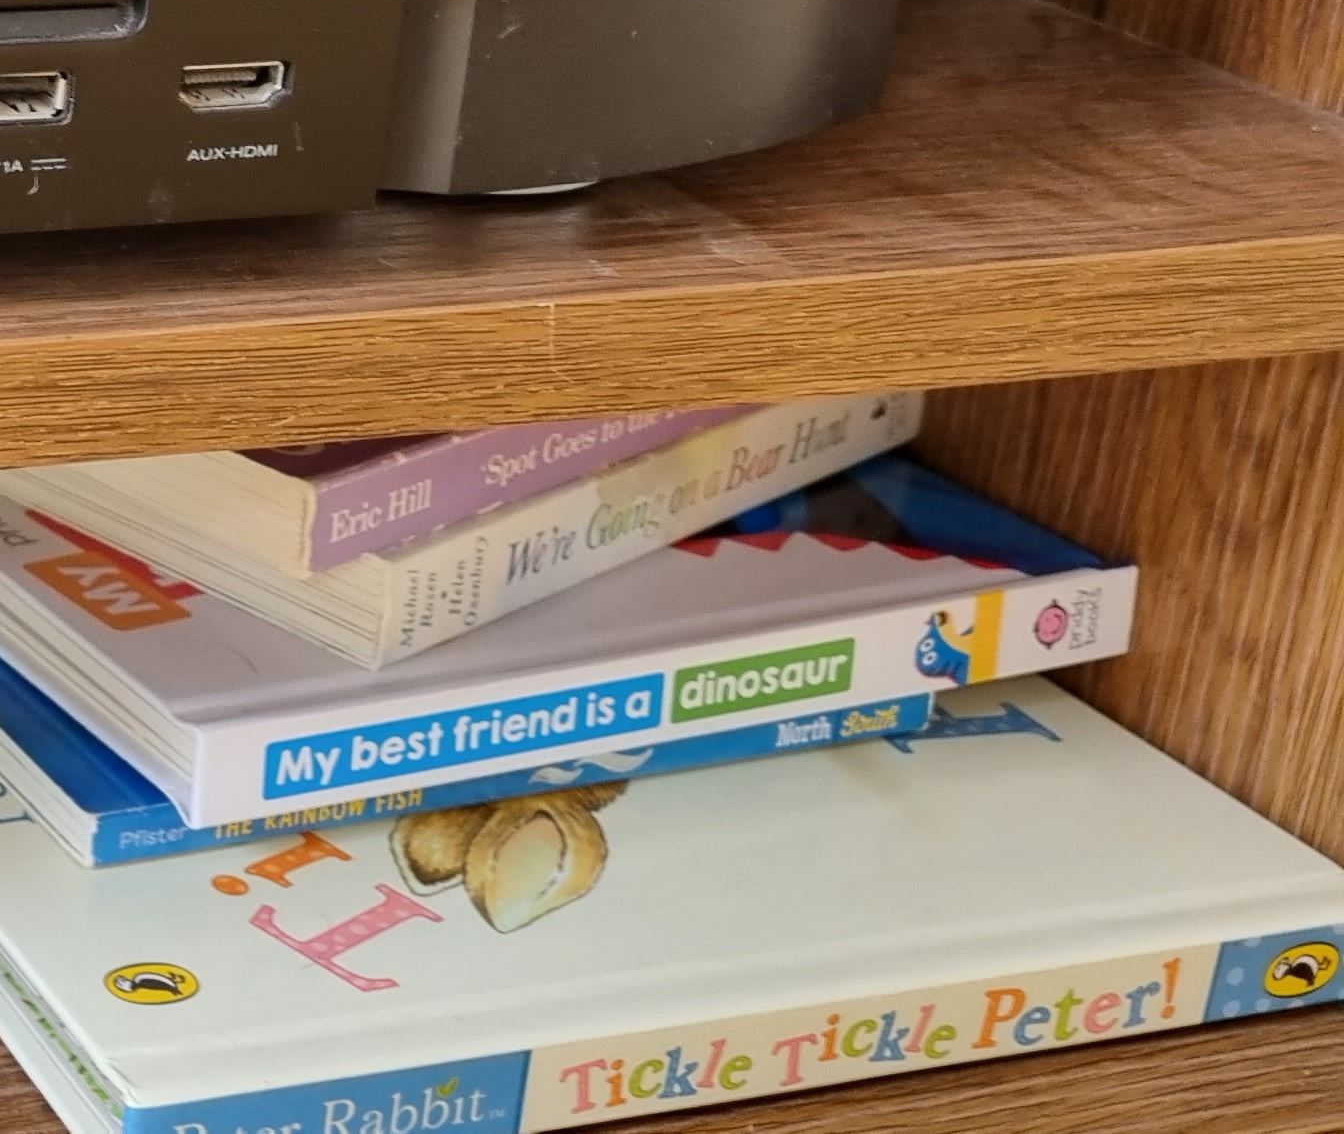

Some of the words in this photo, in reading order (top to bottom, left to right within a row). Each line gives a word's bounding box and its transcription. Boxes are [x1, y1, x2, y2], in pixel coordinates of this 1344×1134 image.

[187, 144, 278, 162] AUX-HDMI
[543, 432, 598, 464] Goes
[600, 420, 624, 443] to
[330, 502, 382, 544] Eric
[386, 478, 432, 522] Hill
[506, 526, 577, 586] We're
[57, 566, 161, 615] MY
[399, 569, 421, 647] Michael
[275, 743, 343, 787] My
[350, 723, 442, 771] best
[453, 696, 576, 752] friend
[585, 693, 615, 727] is
[624, 689, 652, 719] a
[679, 651, 848, 710] dinosaur
[776, 715, 831, 747] North
[214, 819, 254, 839] THE
[558, 1037, 753, 1115] Tickle
[772, 1004, 958, 1087] Tickle
[971, 957, 1182, 1050] Peter!
